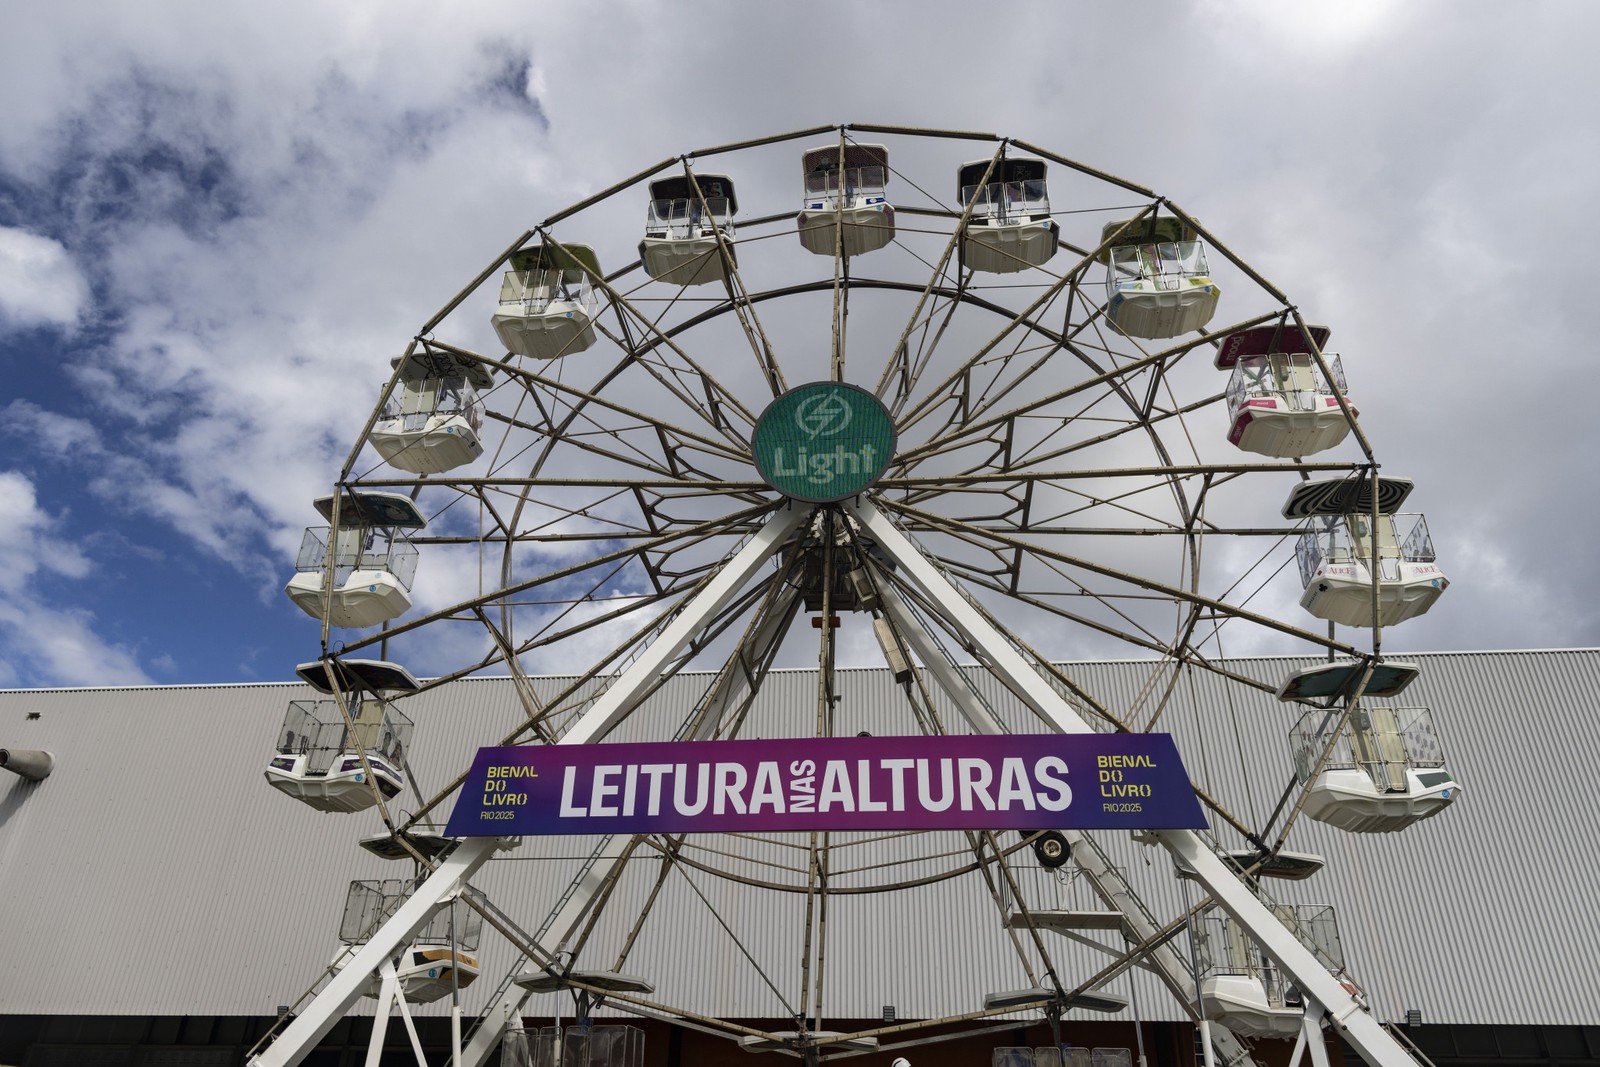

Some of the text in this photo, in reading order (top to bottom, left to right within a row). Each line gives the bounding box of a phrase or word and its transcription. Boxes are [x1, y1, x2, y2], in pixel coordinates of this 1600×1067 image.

[773, 443, 877, 484] Light
[487, 766, 539, 778] BIENAL
[1097, 755, 1157, 768] BIENAL
[559, 755, 1073, 818] LEITURA NAS ALTURAS
